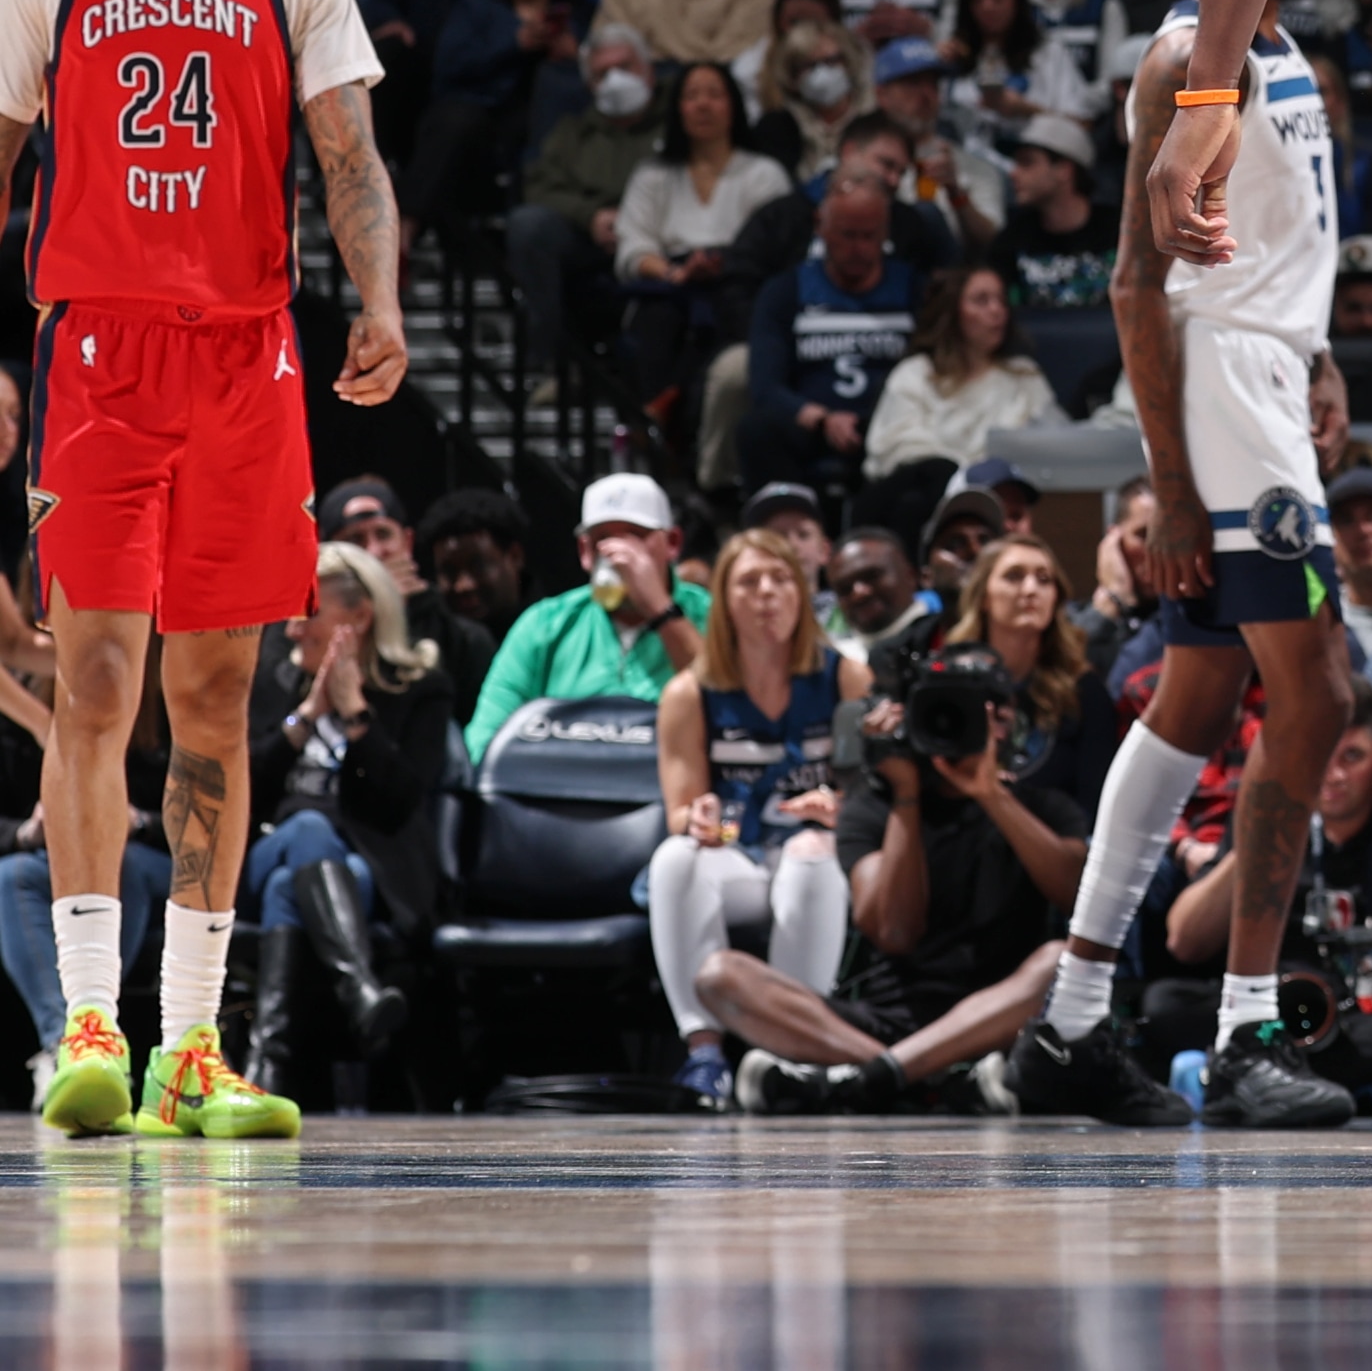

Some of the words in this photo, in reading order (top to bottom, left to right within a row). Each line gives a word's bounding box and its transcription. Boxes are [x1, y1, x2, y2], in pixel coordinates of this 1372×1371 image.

[117, 51, 217, 149] 24
[127, 165, 206, 213] CITY
[832, 353, 868, 399] 5
